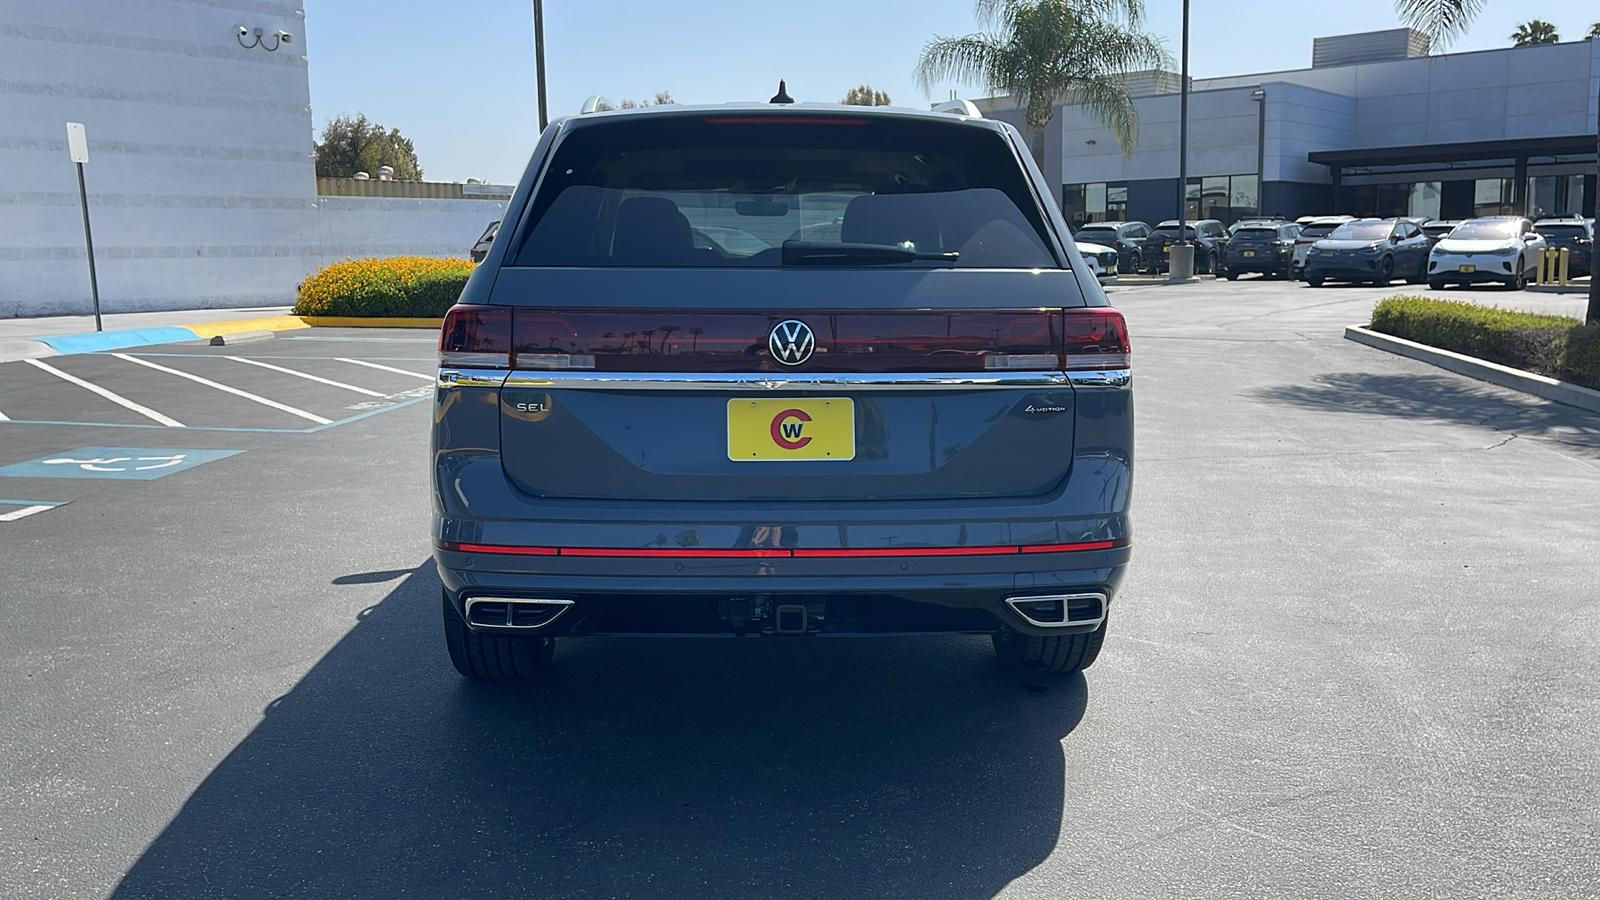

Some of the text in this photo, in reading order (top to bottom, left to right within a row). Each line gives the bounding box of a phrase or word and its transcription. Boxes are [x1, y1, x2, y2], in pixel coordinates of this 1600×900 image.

[771, 321, 813, 363] VW
[736, 377, 848, 387] ATLAS
[516, 402, 550, 412] SEL
[1024, 404, 1066, 414] 4MOTION
